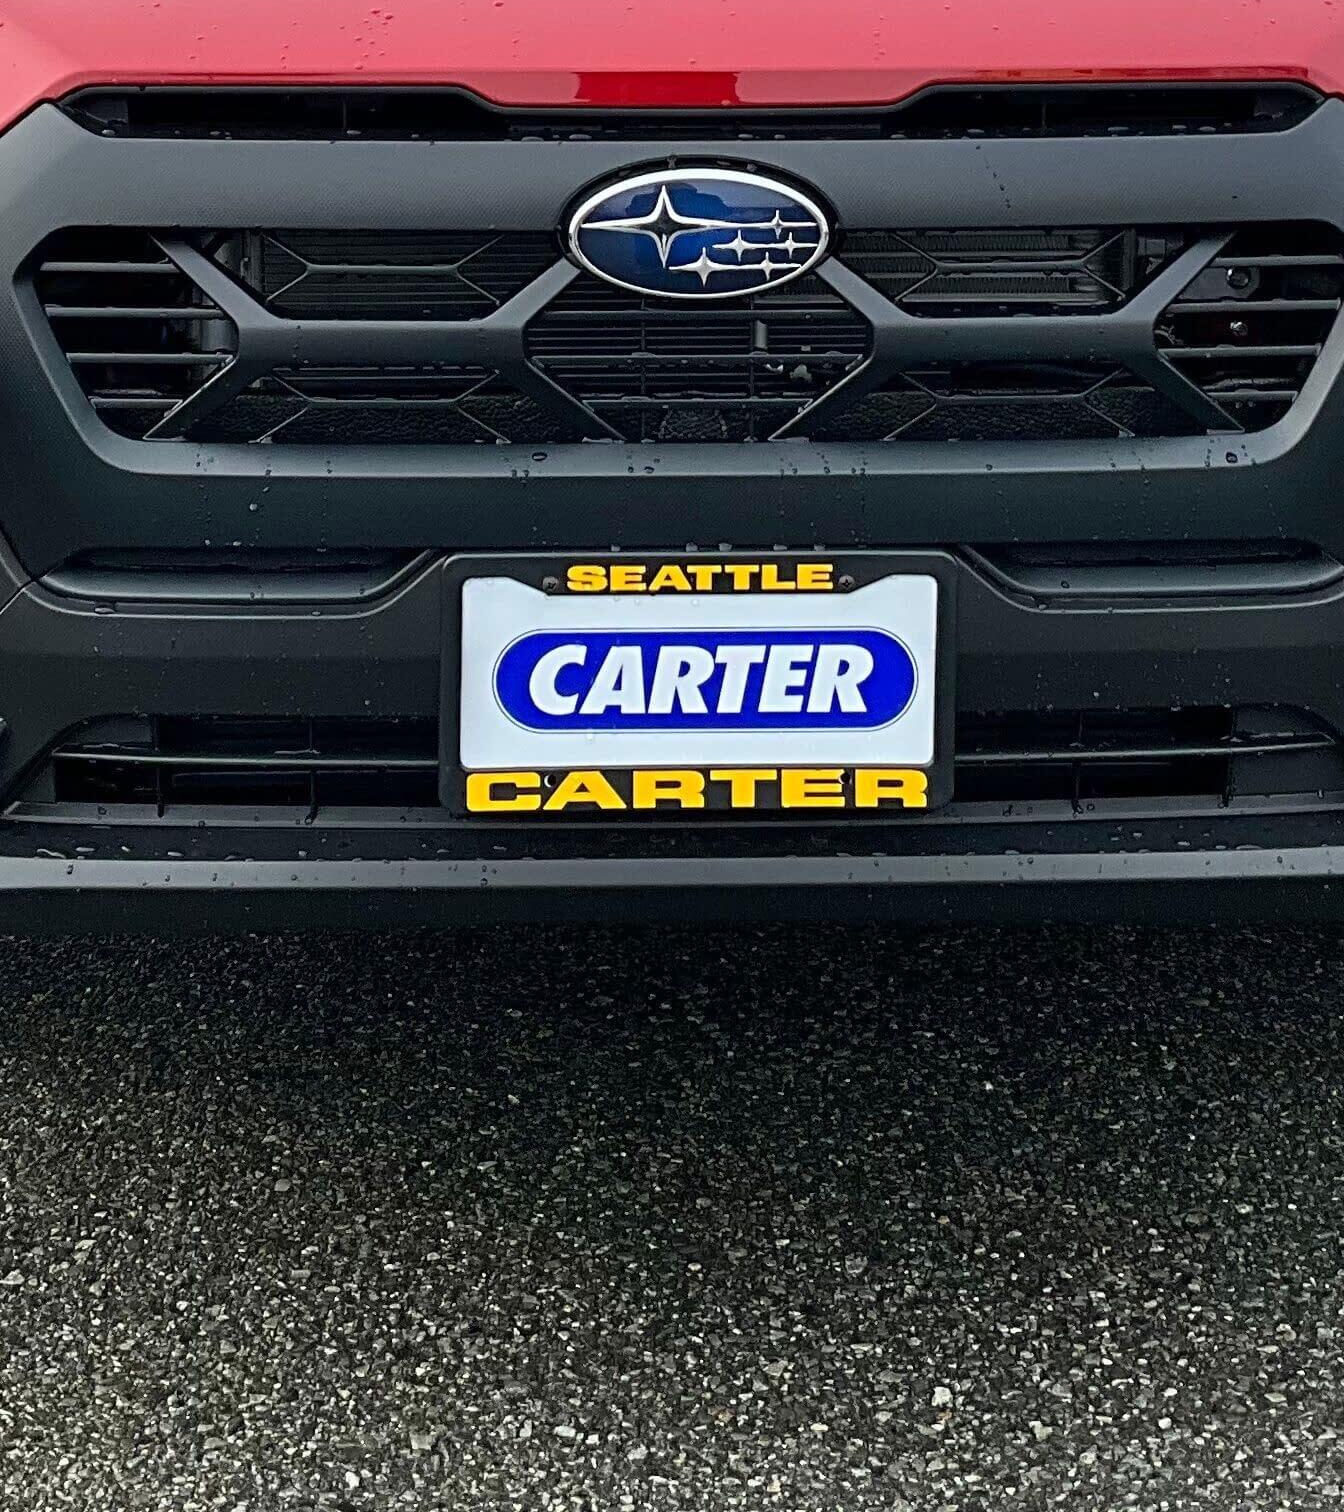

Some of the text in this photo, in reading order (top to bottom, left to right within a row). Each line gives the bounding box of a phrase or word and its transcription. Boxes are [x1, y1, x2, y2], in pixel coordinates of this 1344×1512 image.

[567, 564, 834, 591] SEATTLE
[529, 643, 874, 715] CARTER
[466, 768, 928, 812] CARTER
